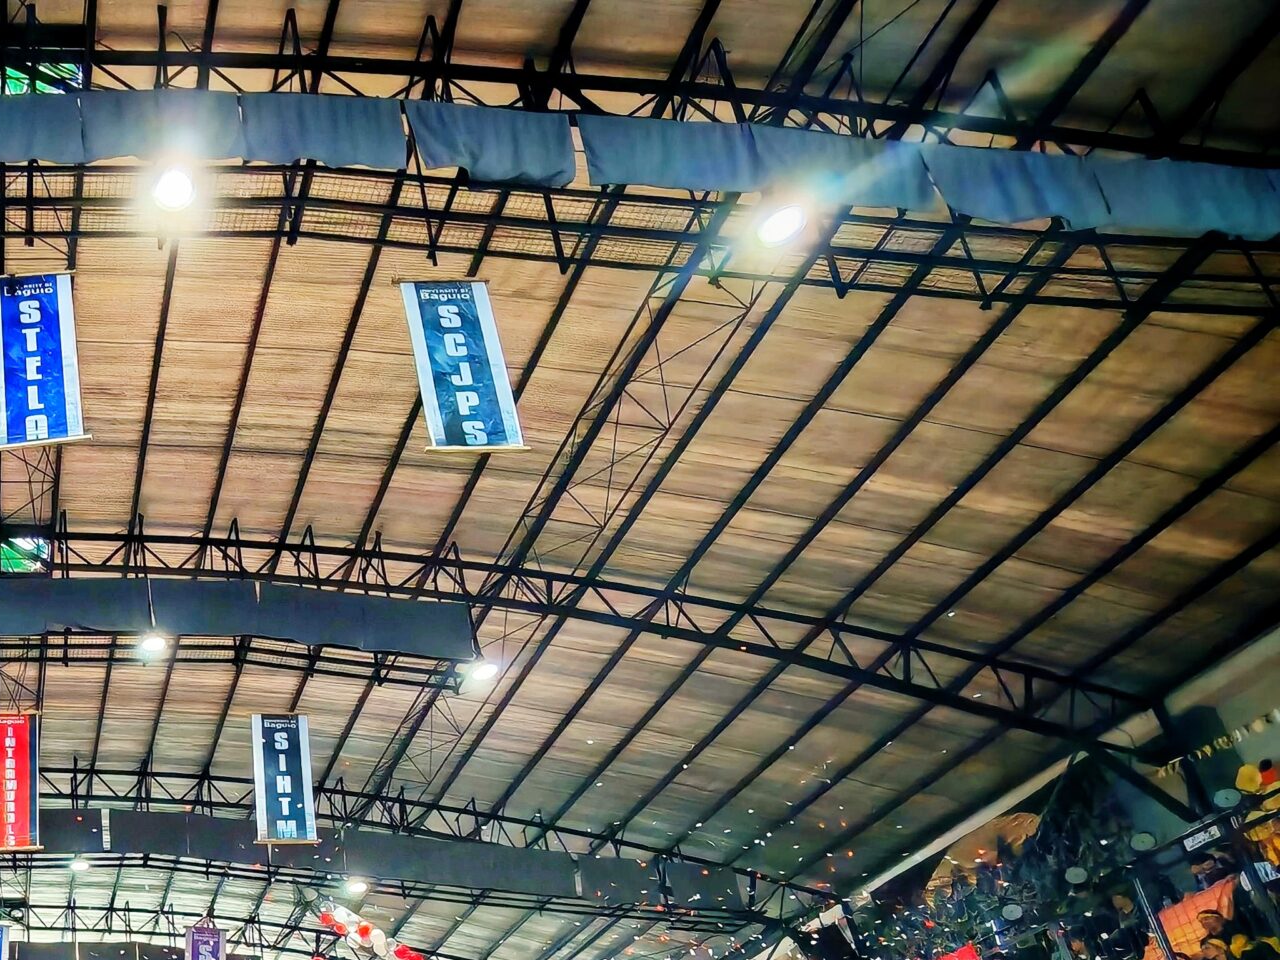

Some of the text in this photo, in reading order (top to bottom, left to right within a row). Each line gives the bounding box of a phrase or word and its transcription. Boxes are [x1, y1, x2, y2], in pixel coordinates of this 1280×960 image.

[421, 292, 470, 301] Baguio
[18, 300, 49, 441] STELA
[437, 305, 488, 446] SCJPS
[274, 731, 297, 839] SIHTM
